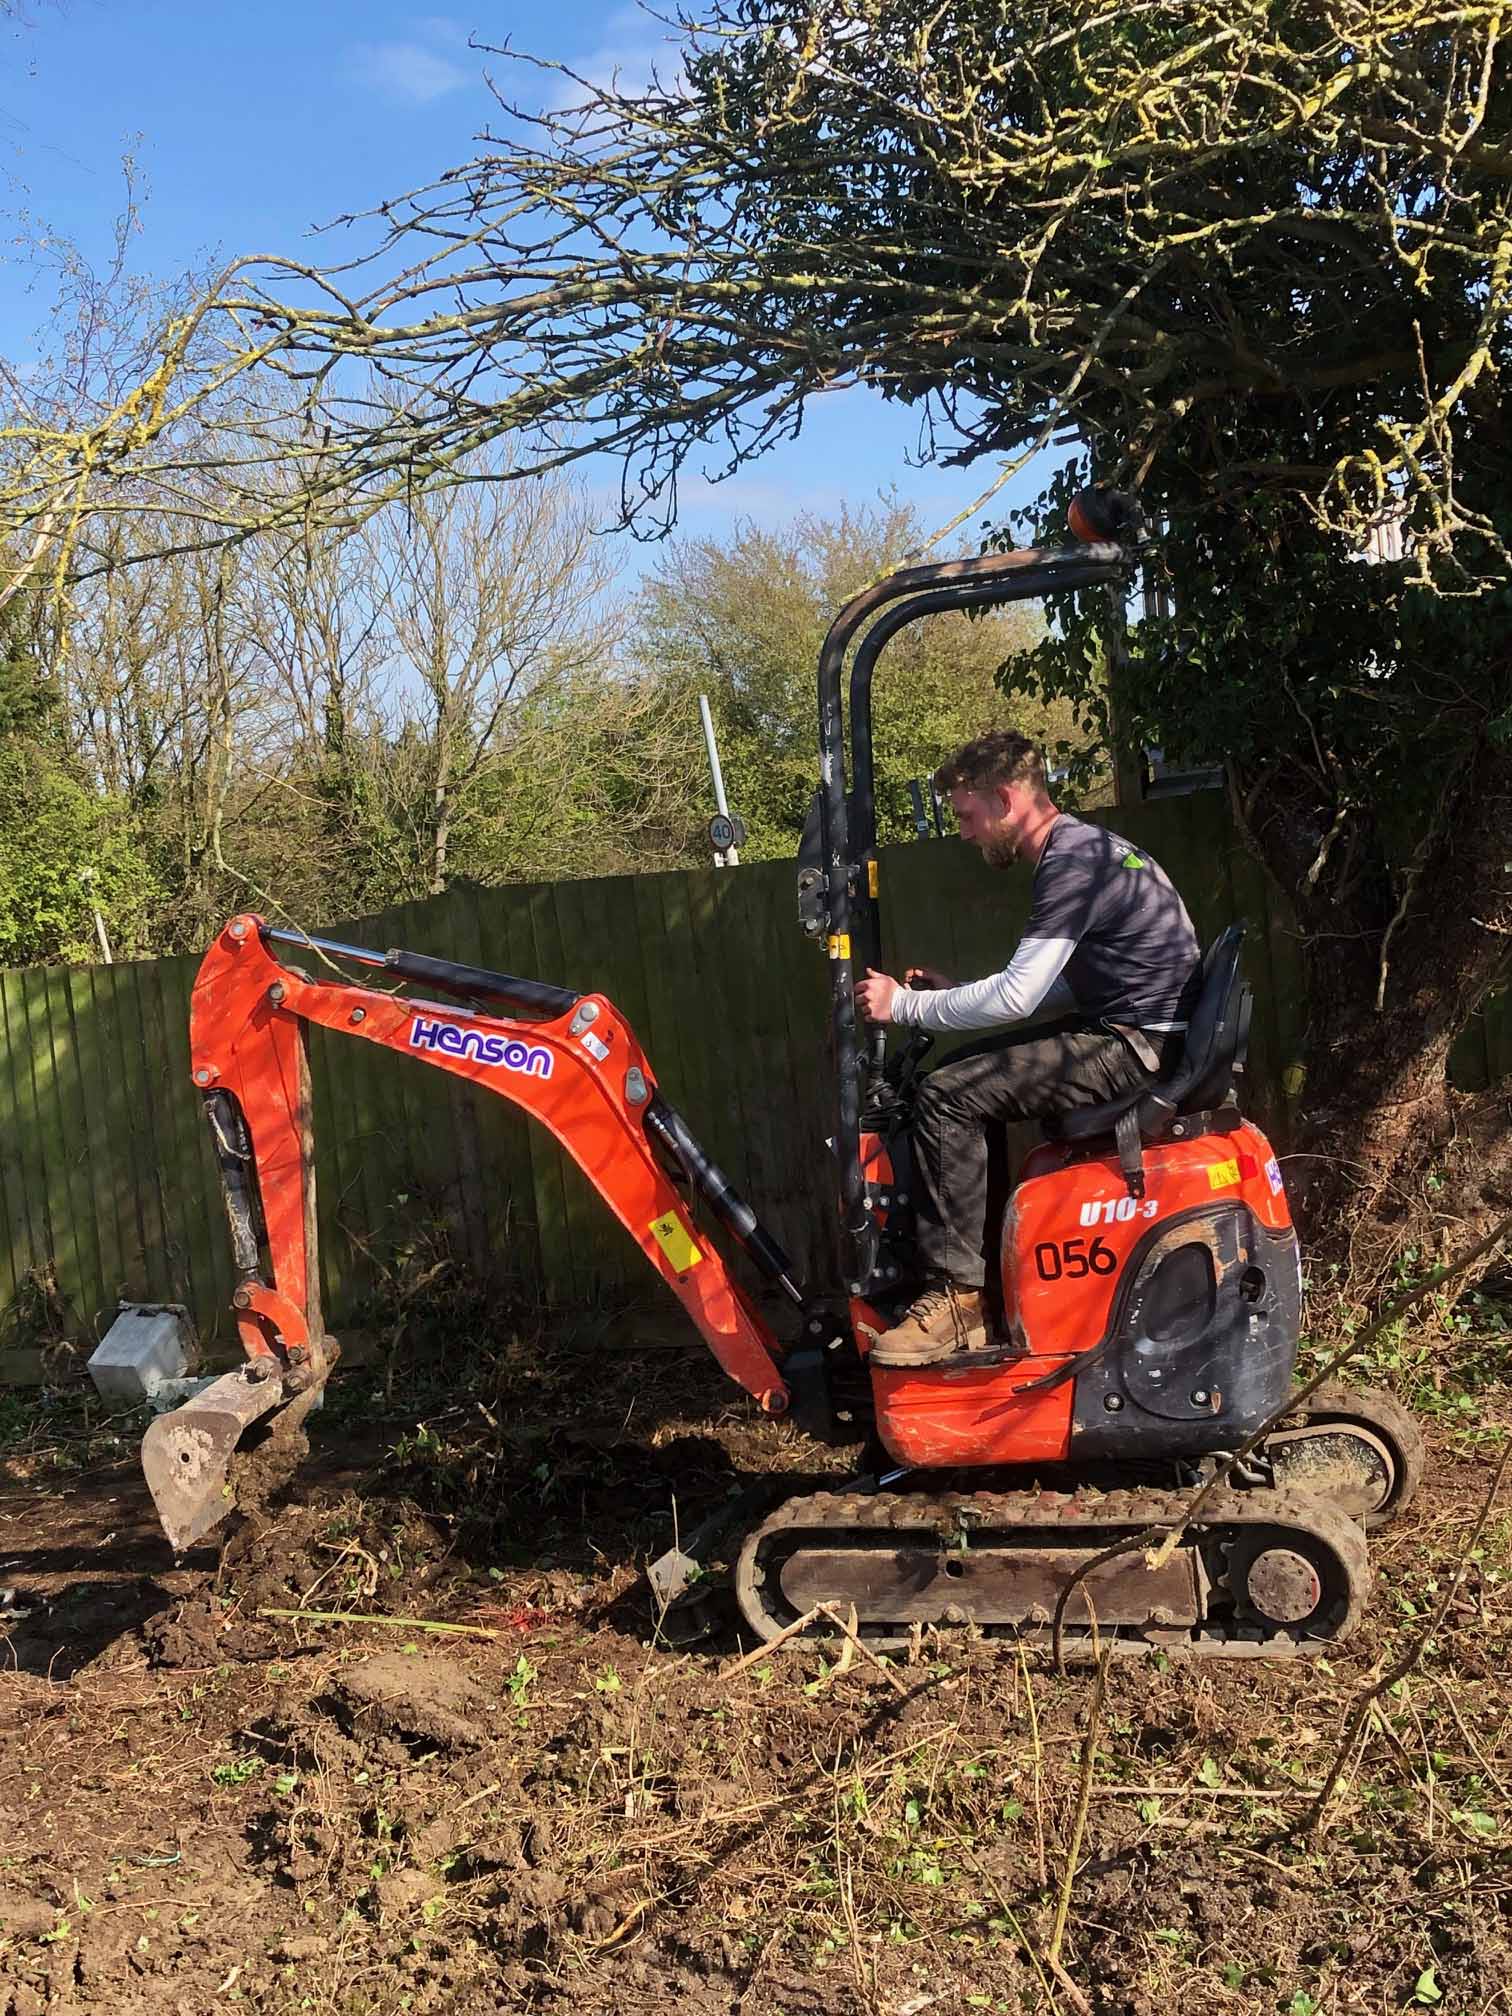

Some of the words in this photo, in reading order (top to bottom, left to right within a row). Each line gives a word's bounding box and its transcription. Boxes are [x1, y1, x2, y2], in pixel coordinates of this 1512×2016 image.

[713, 824, 730, 839] 40
[411, 1017, 553, 1077] Henson
[1080, 1196, 1158, 1227] U10-3
[1035, 1236, 1117, 1281] 056
